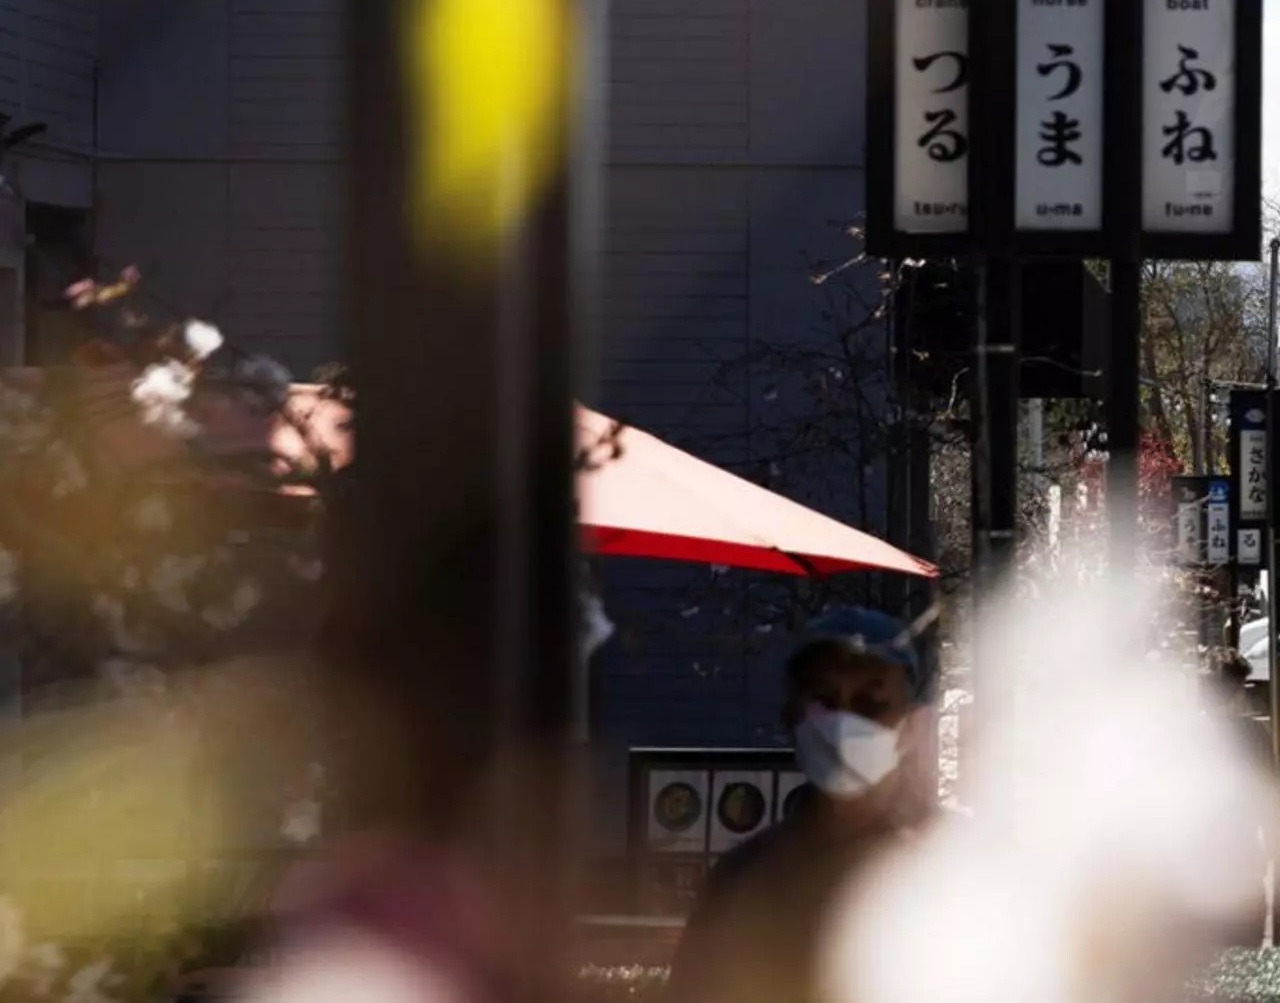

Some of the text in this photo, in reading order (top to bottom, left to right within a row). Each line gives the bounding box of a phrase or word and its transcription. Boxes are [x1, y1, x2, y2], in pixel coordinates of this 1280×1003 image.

[912, 50, 969, 164] つる
[1035, 42, 1083, 168] うま
[1158, 43, 1217, 166] ふね
[1248, 446, 1266, 503] さかな
